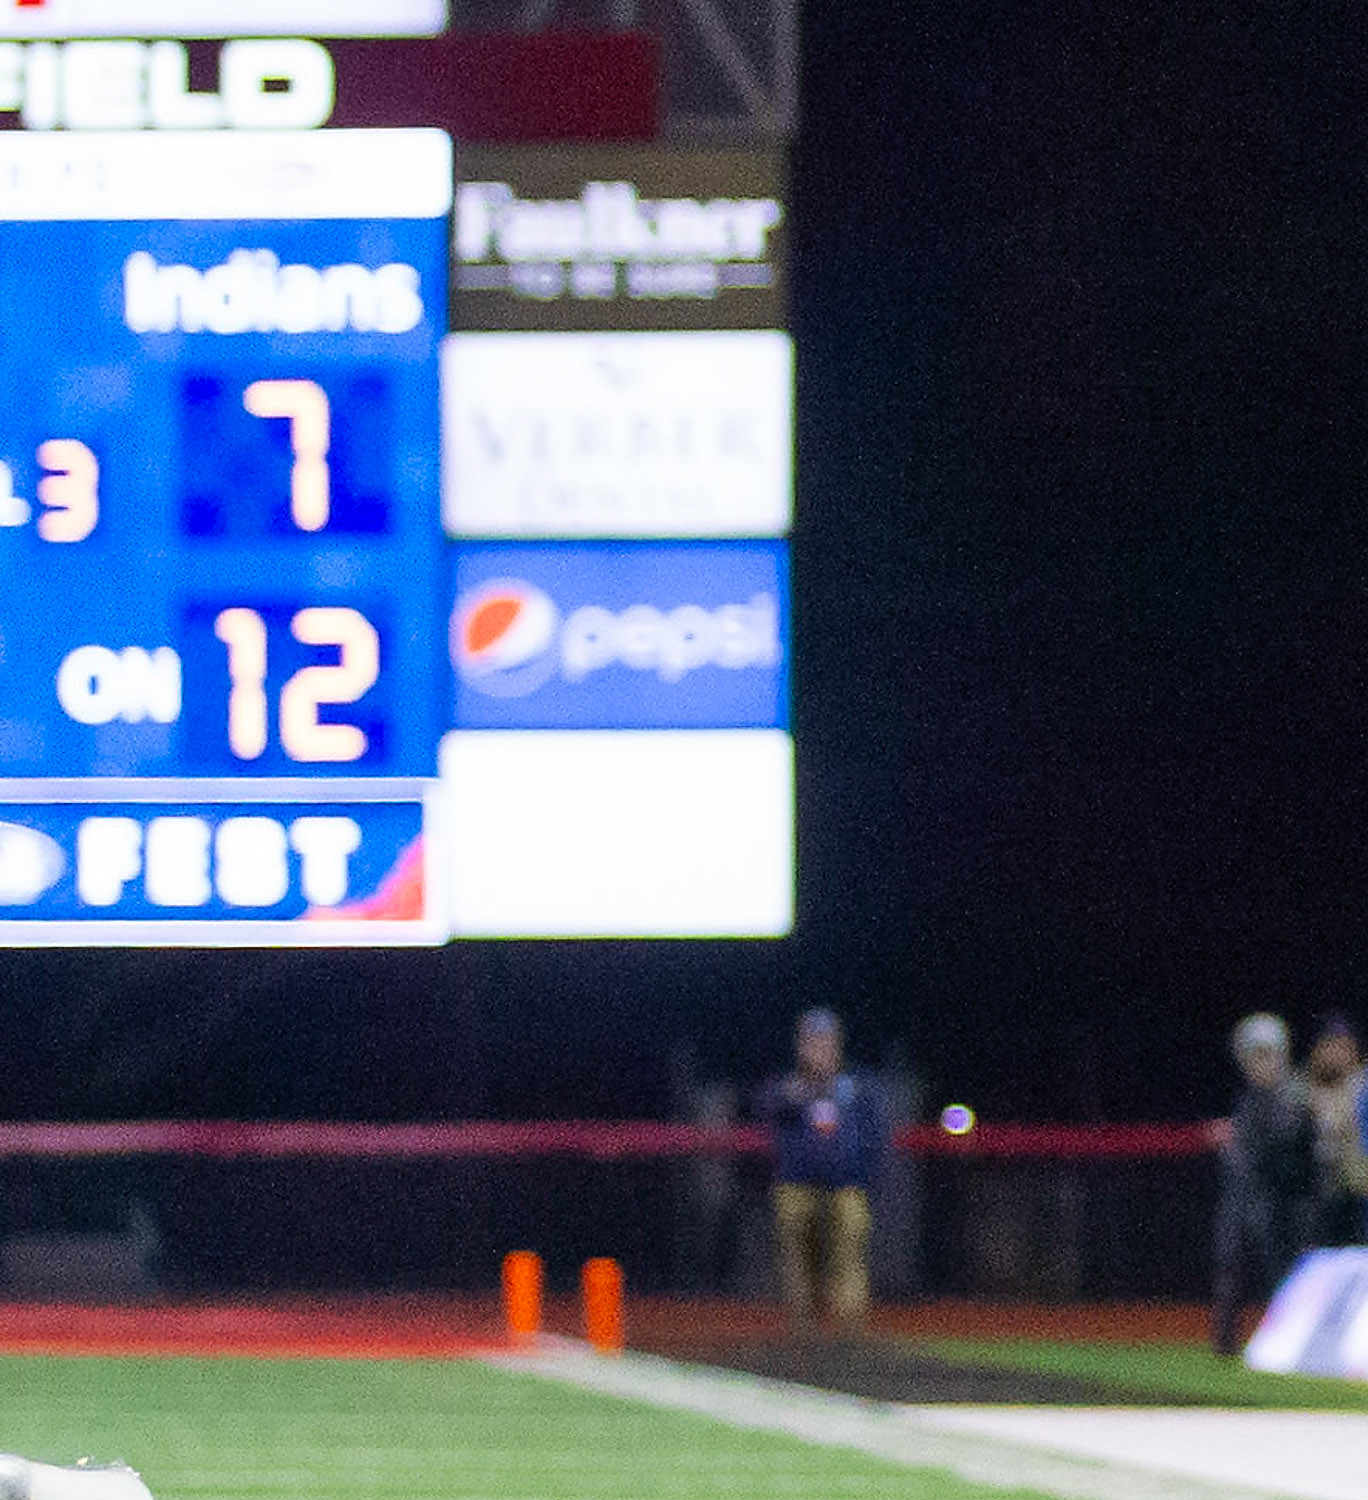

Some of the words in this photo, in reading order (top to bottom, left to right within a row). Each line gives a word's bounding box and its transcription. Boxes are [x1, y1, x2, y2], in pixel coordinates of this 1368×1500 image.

[0, 39, 335, 129] IELD
[455, 180, 784, 261] Faulkner
[124, 248, 423, 335] Indians
[36, 438, 99, 542] 3
[243, 379, 330, 531] 7
[562, 592, 778, 683] pepsi
[58, 644, 183, 725] ON
[214, 607, 380, 762] 12
[77, 815, 362, 907] FEST
